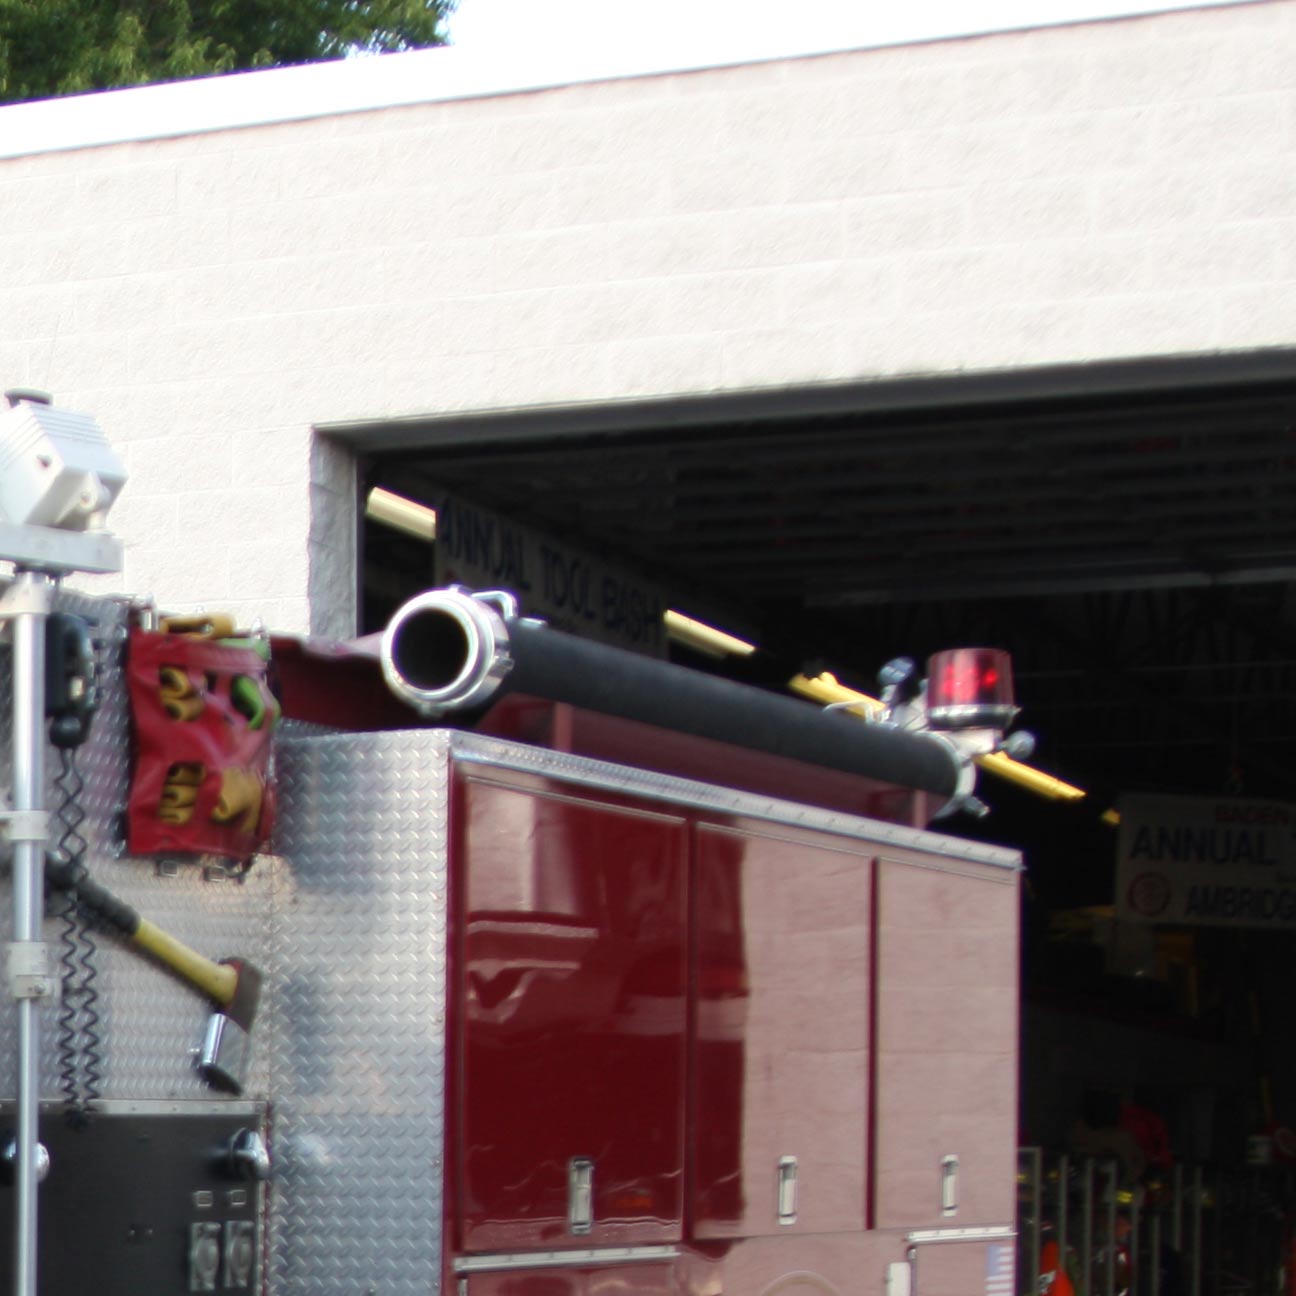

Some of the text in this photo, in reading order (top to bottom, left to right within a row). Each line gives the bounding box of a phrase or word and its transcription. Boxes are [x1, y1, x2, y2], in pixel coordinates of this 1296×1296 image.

[440, 496, 660, 645] ANNUAL TOOL BASH
[1130, 824, 1280, 866] ANNUAL
